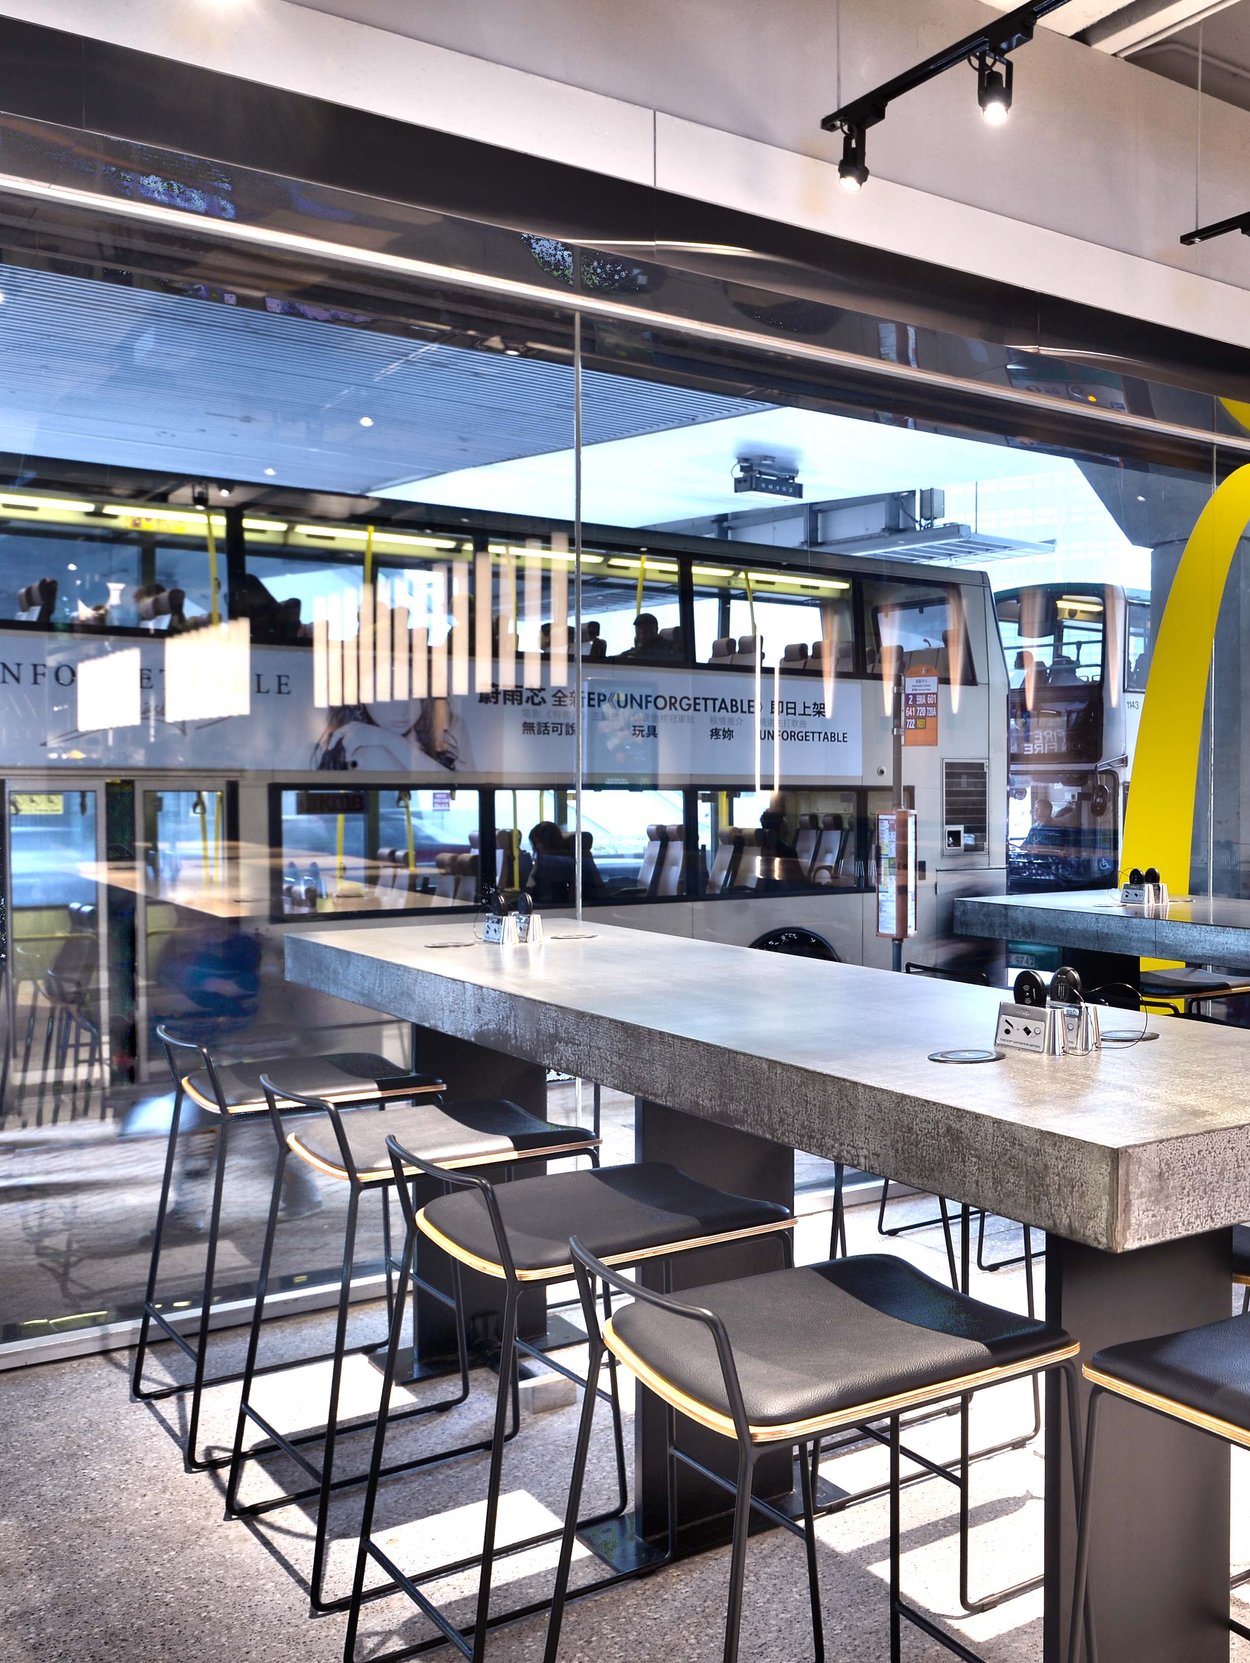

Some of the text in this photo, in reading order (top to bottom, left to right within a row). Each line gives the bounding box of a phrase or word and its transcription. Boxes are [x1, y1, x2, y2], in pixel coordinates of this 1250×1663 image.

[0, 661, 292, 695] NFOELE
[1126, 700, 1140, 710] 1143
[905, 707, 915, 717] 641
[916, 707, 926, 716] 720
[631, 724, 659, 738] 玩具
